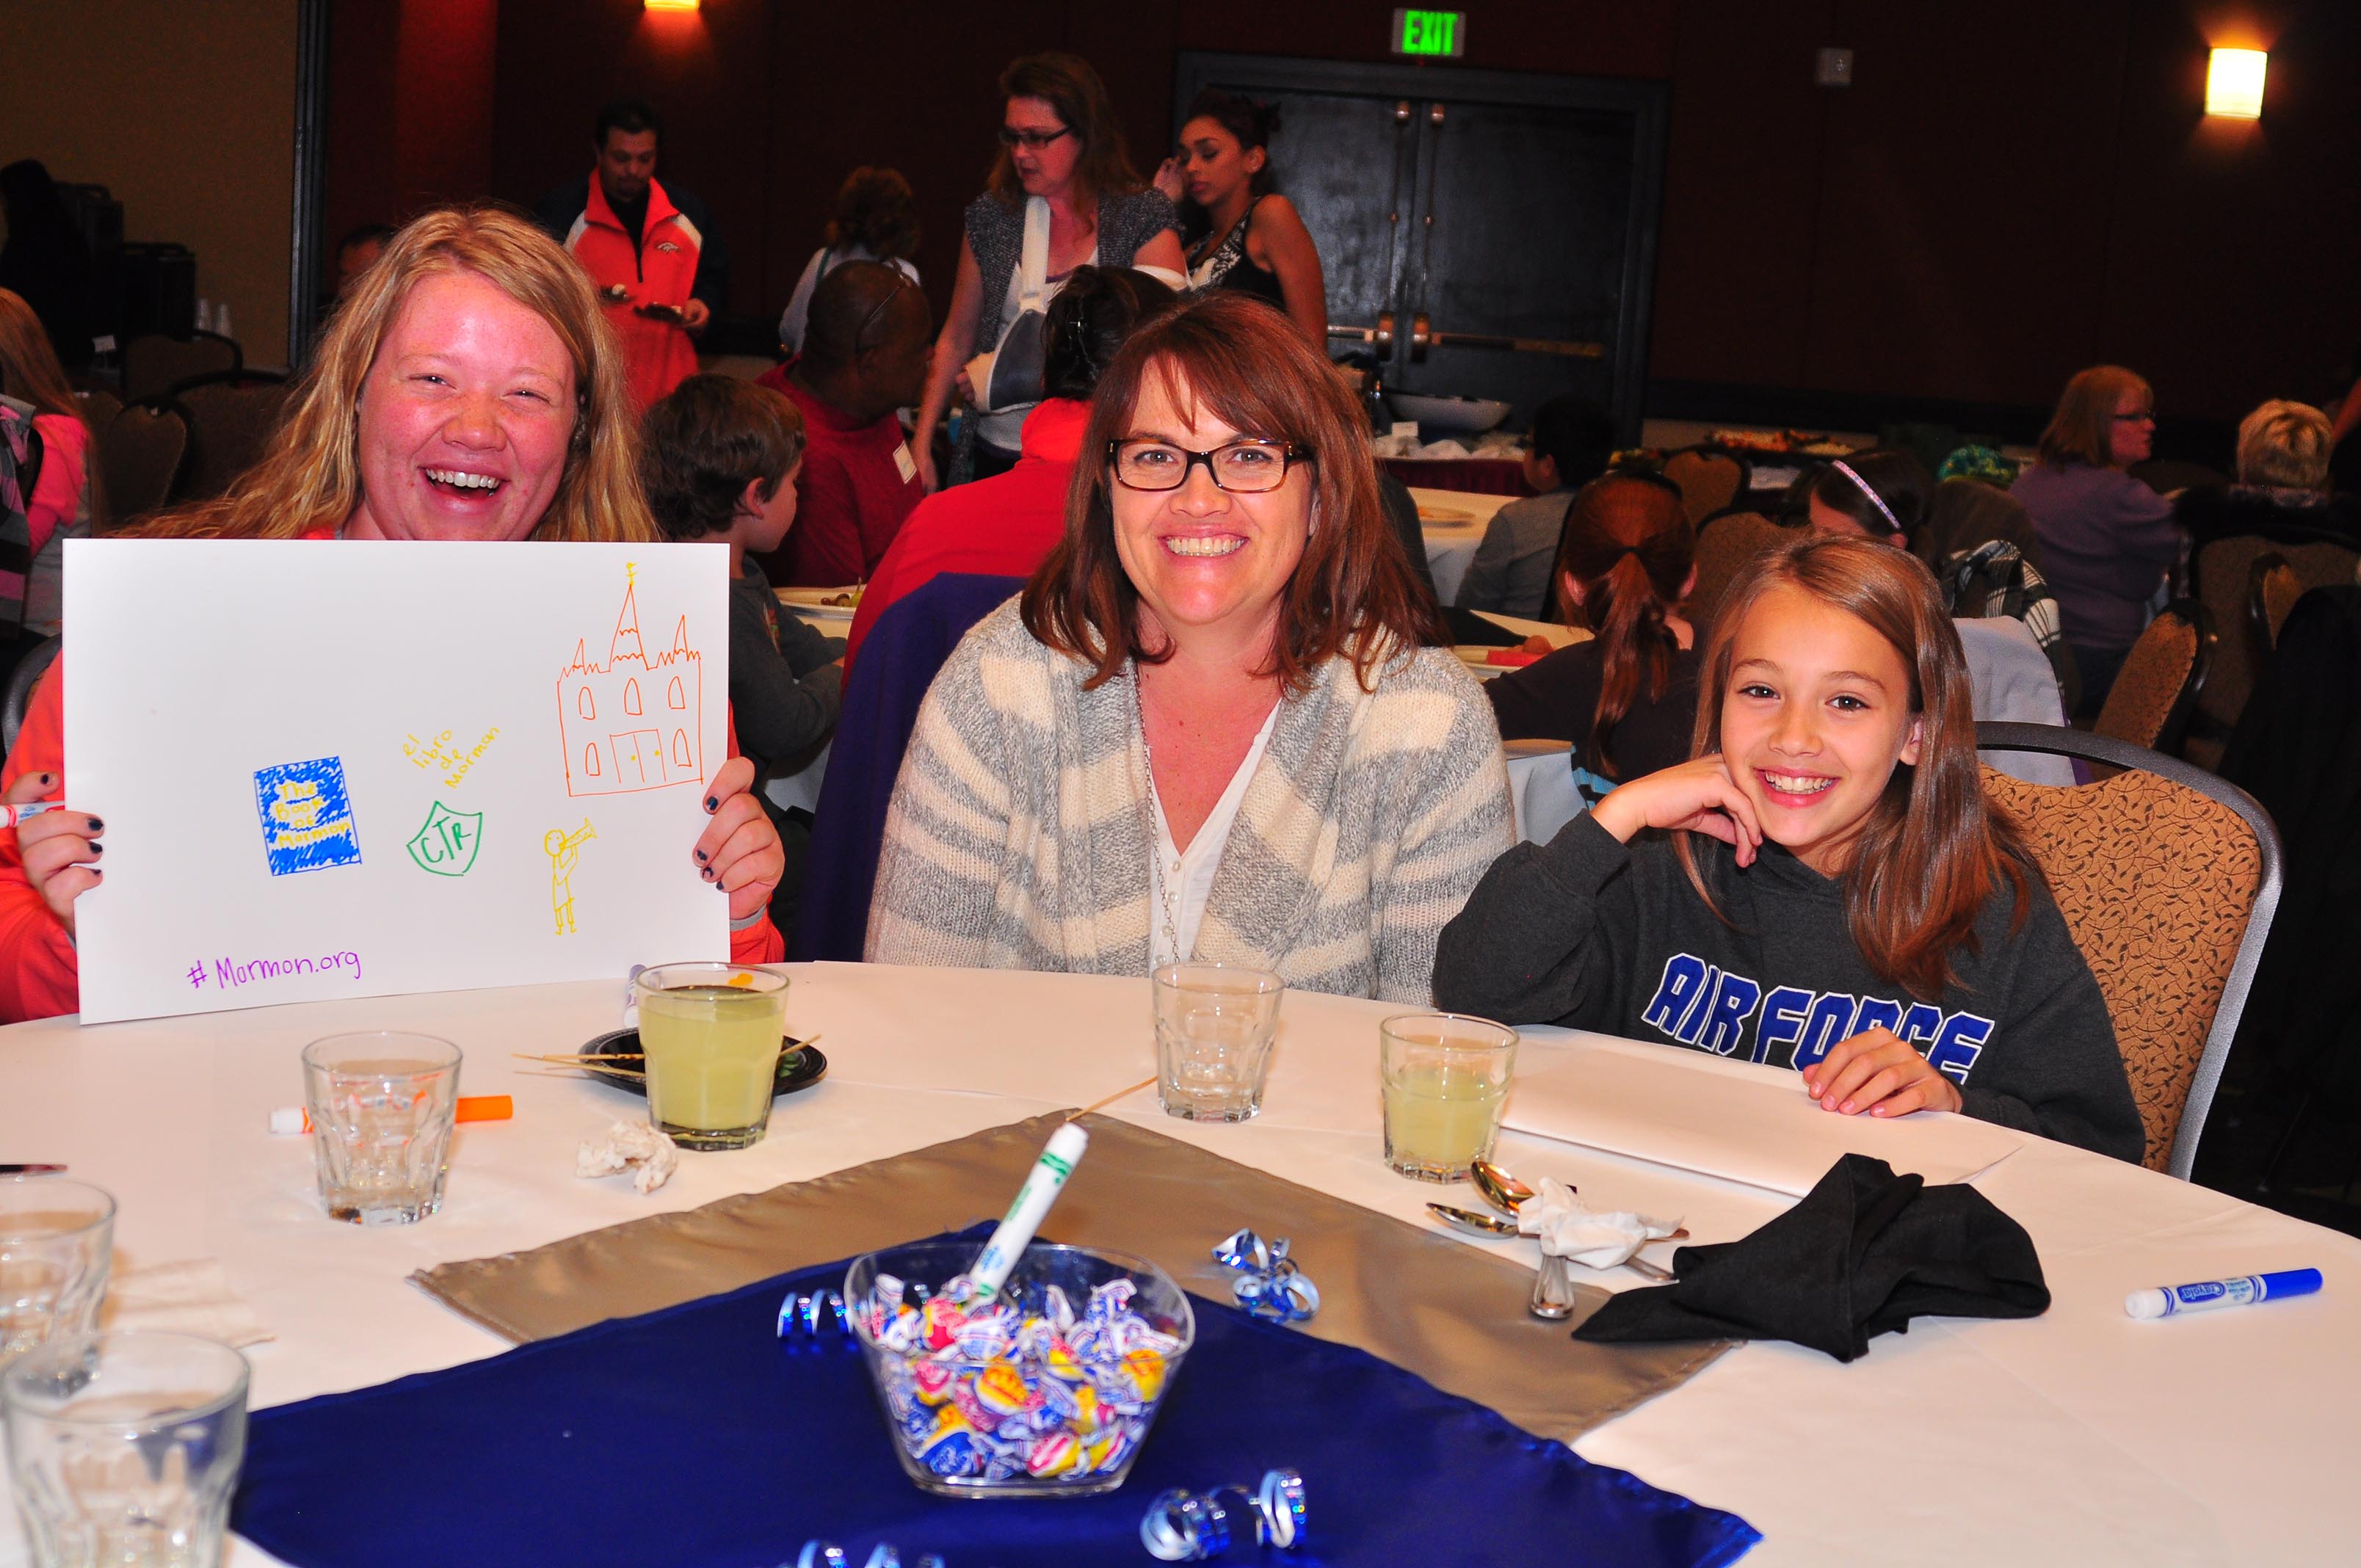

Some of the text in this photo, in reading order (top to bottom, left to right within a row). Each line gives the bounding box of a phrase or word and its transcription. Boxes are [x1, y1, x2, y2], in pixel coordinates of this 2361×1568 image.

[1403, 10, 1458, 55] EXIT
[412, 730, 452, 769] libro
[440, 749, 463, 770] de
[280, 783, 315, 799] The
[275, 798, 324, 821] Book
[294, 815, 315, 828] of
[278, 822, 351, 847] Mormon
[421, 816, 471, 863] CTR
[1641, 952, 1762, 1056] AIR
